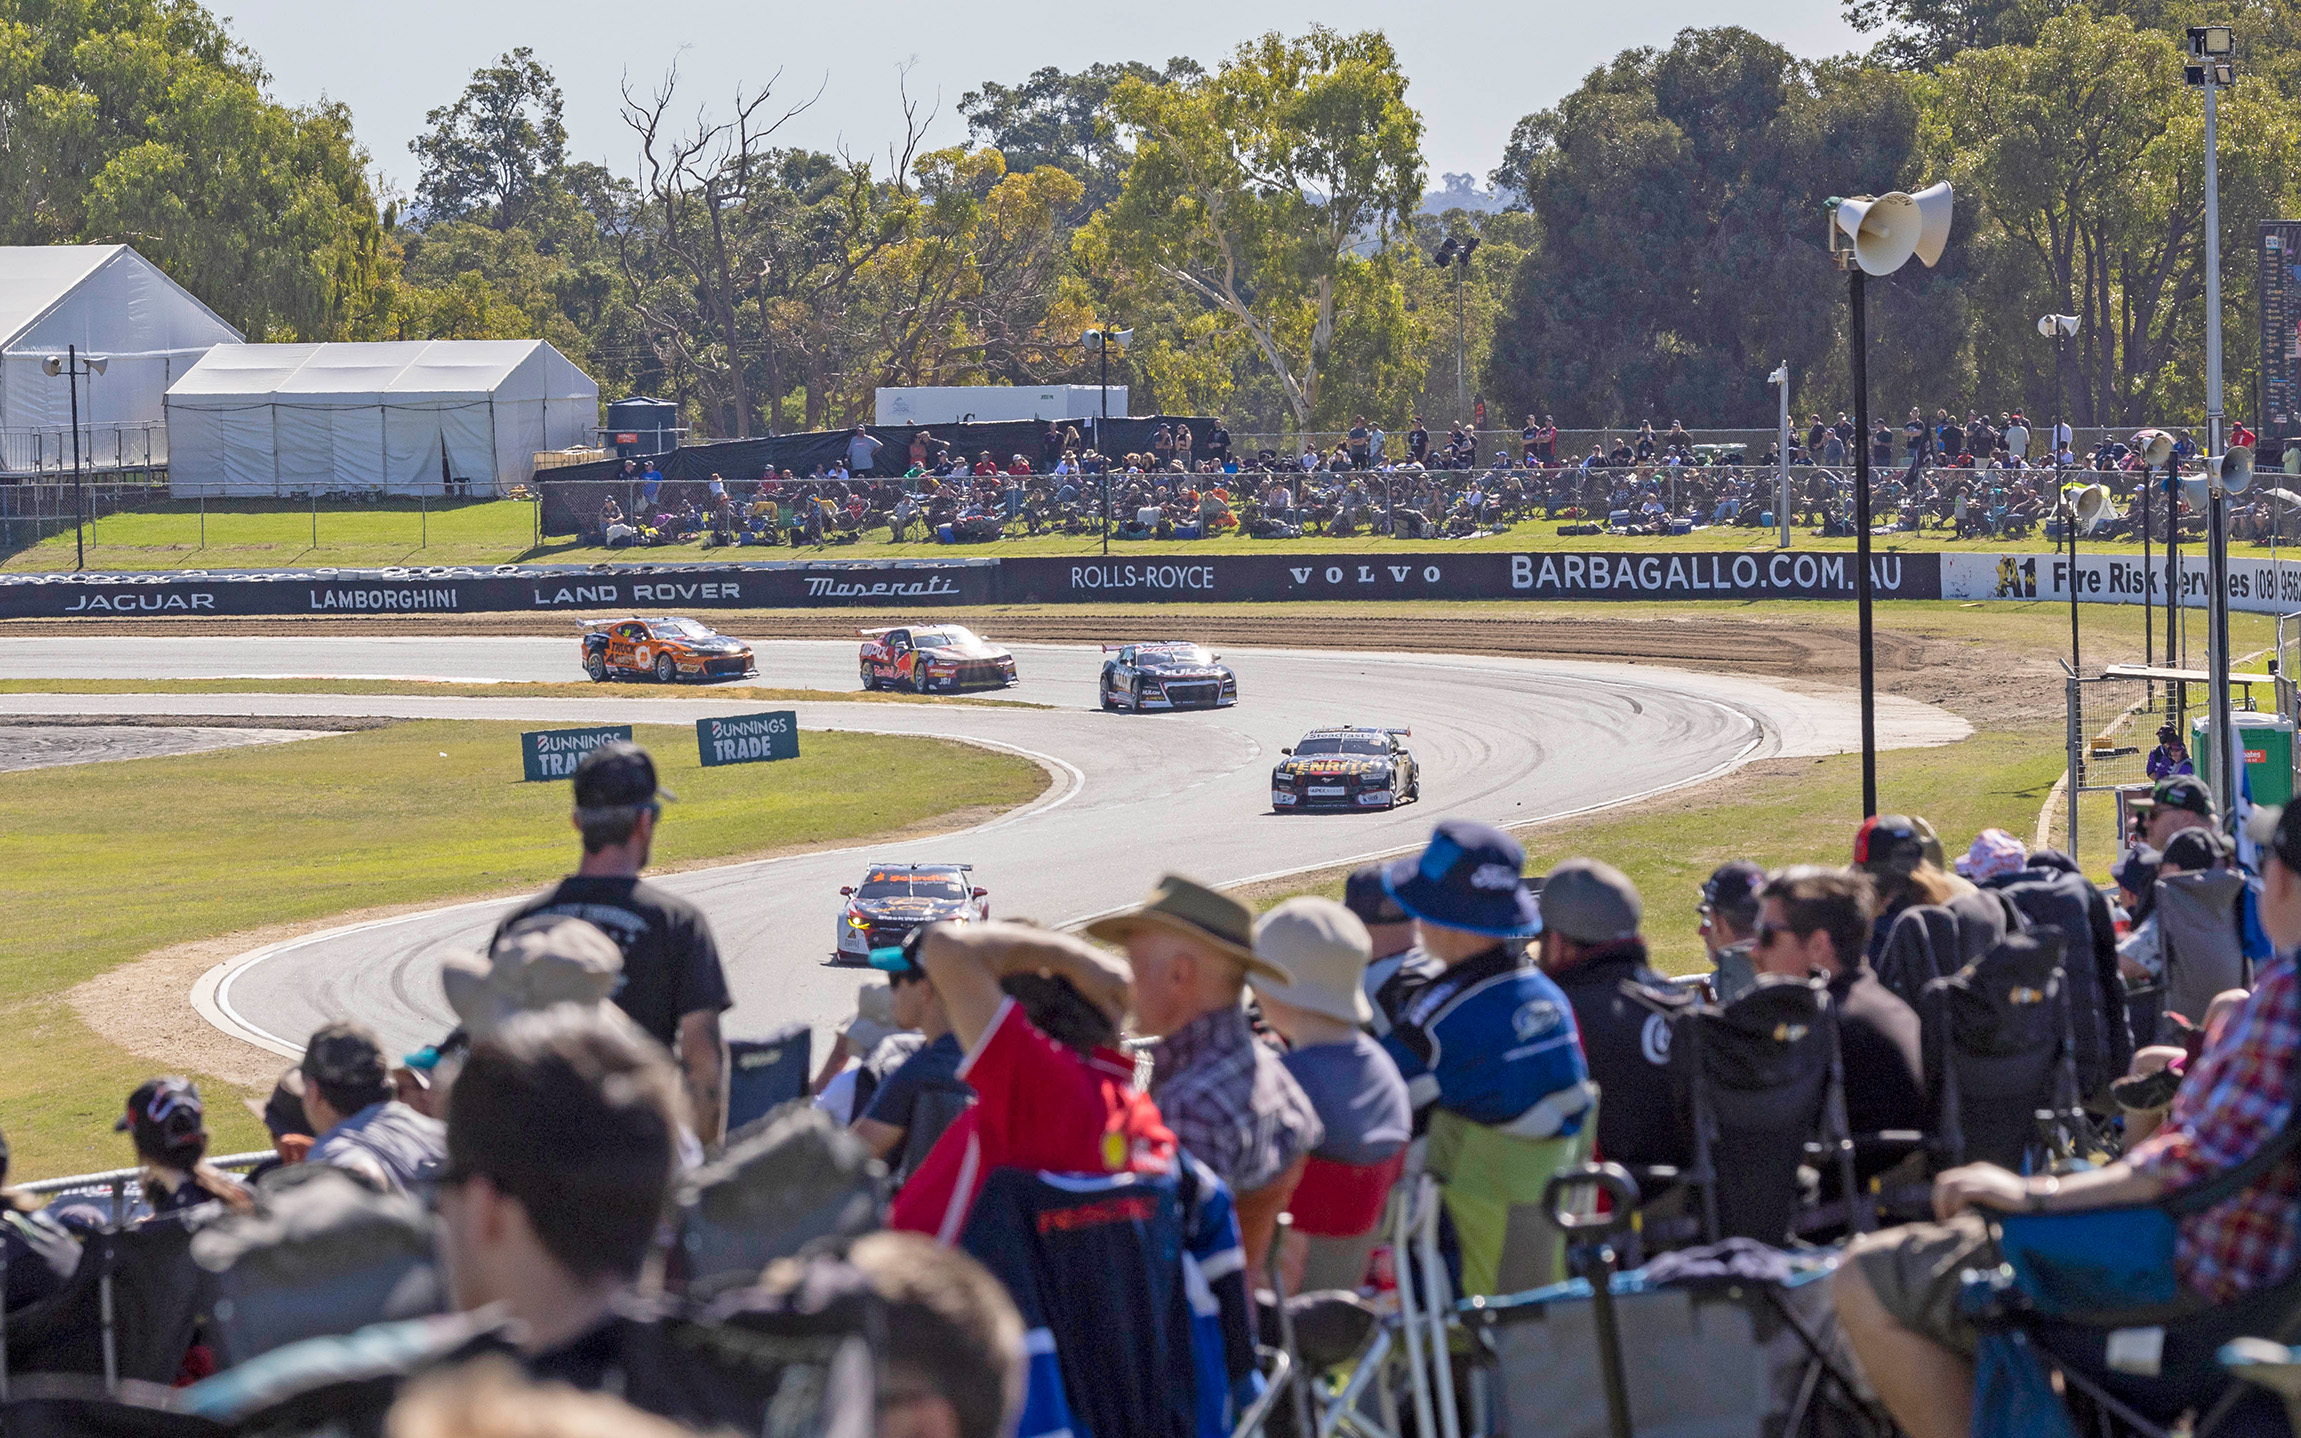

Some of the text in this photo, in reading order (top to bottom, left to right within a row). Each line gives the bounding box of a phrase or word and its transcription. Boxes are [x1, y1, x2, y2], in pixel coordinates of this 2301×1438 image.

[1071, 565, 1214, 589] ROLLS-ROYCE
[1289, 566, 1441, 584] VOLVO
[1996, 556, 2036, 598] A1
[2109, 562, 2157, 594] Risk
[2165, 564, 2249, 598] erves
[535, 582, 740, 604] LAND ROVER
[804, 576, 960, 597] Maserati
[65, 593, 215, 612] JAGUAR
[310, 589, 458, 609] LAMBORGHINI
[711, 718, 787, 738] BUNNINGS
[536, 732, 620, 752] BUNNINGS
[713, 736, 771, 761] TRADE
[538, 751, 591, 775] TRA
[1285, 760, 1372, 773] PENRITE
